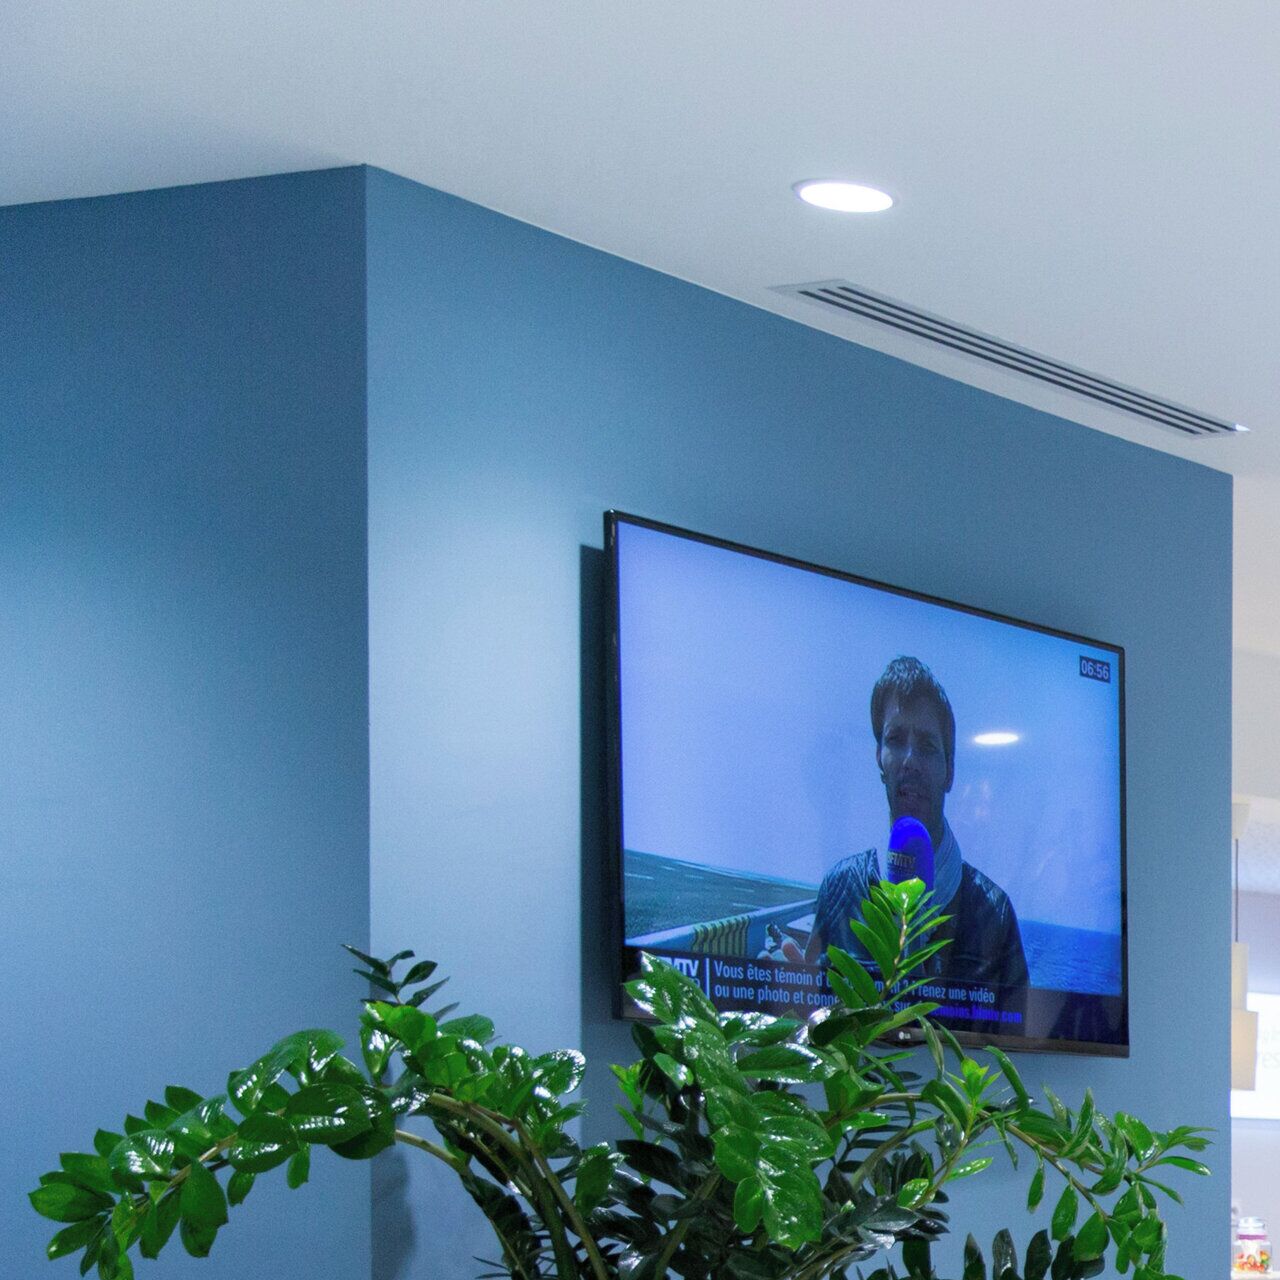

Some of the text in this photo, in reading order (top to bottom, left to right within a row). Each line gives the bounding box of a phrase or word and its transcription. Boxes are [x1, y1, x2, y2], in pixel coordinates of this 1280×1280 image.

[714, 960, 744, 979] Vous
[747, 963, 771, 982] êtes
[775, 967, 813, 986] témoin
[949, 988, 967, 1001] une
[969, 987, 995, 1004] vidéo
[714, 984, 730, 998] ou
[733, 986, 755, 1000] une
[757, 985, 790, 1004] photo
[793, 990, 805, 1004] et
